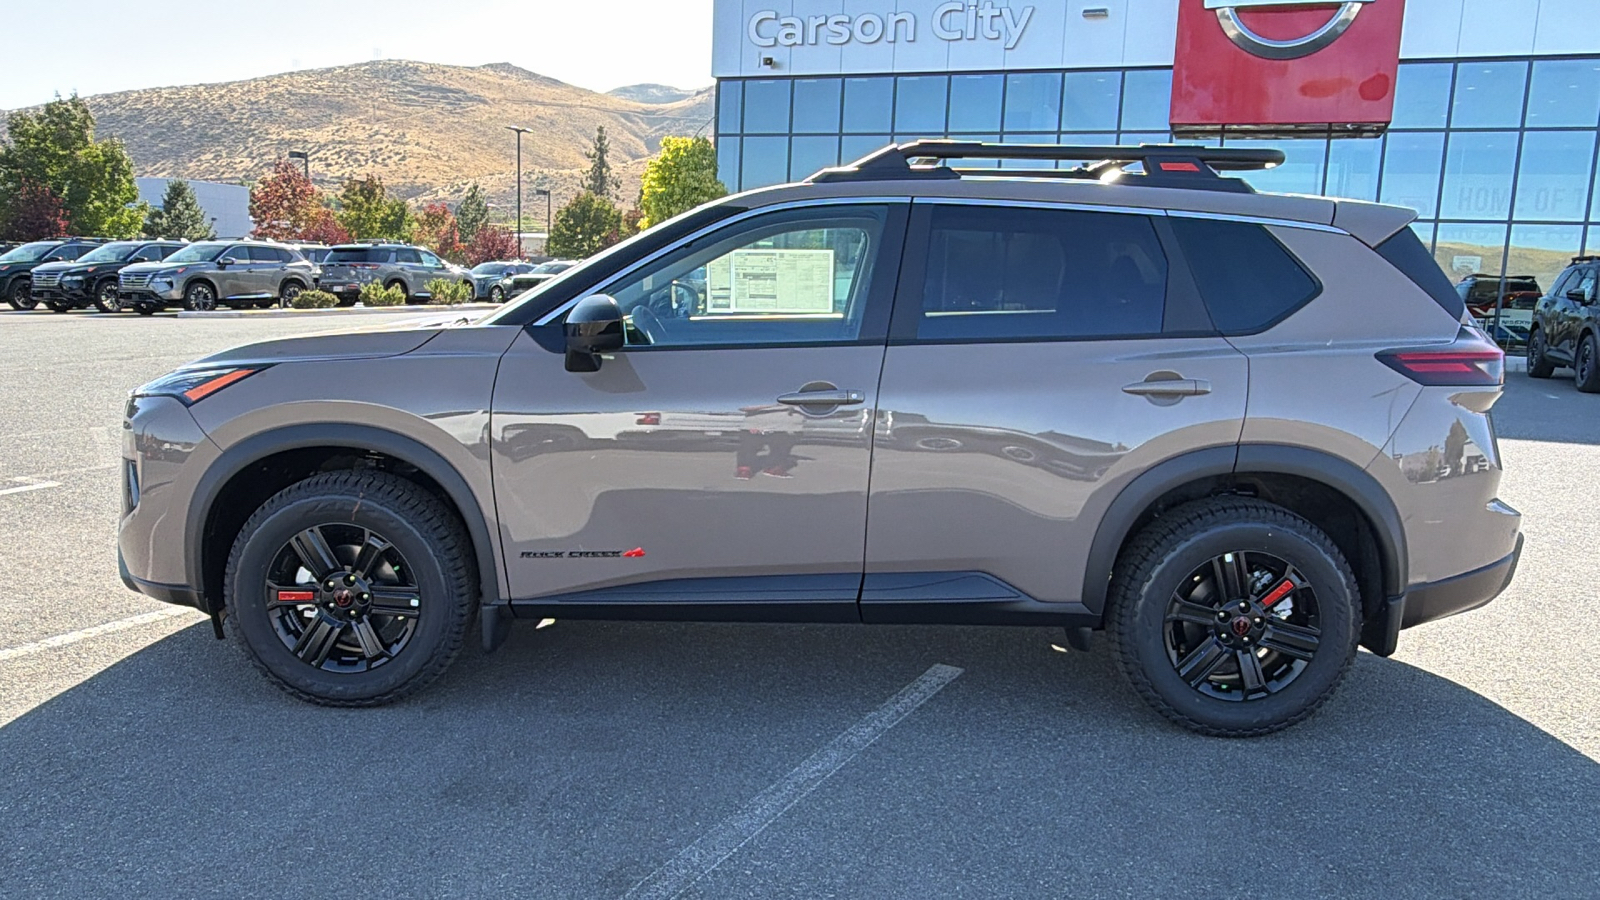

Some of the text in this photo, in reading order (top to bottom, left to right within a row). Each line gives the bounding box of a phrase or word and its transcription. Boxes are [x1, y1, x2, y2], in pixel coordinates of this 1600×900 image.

[748, 1, 1035, 50] Carson City
[567, 550, 622, 558] CREEK
